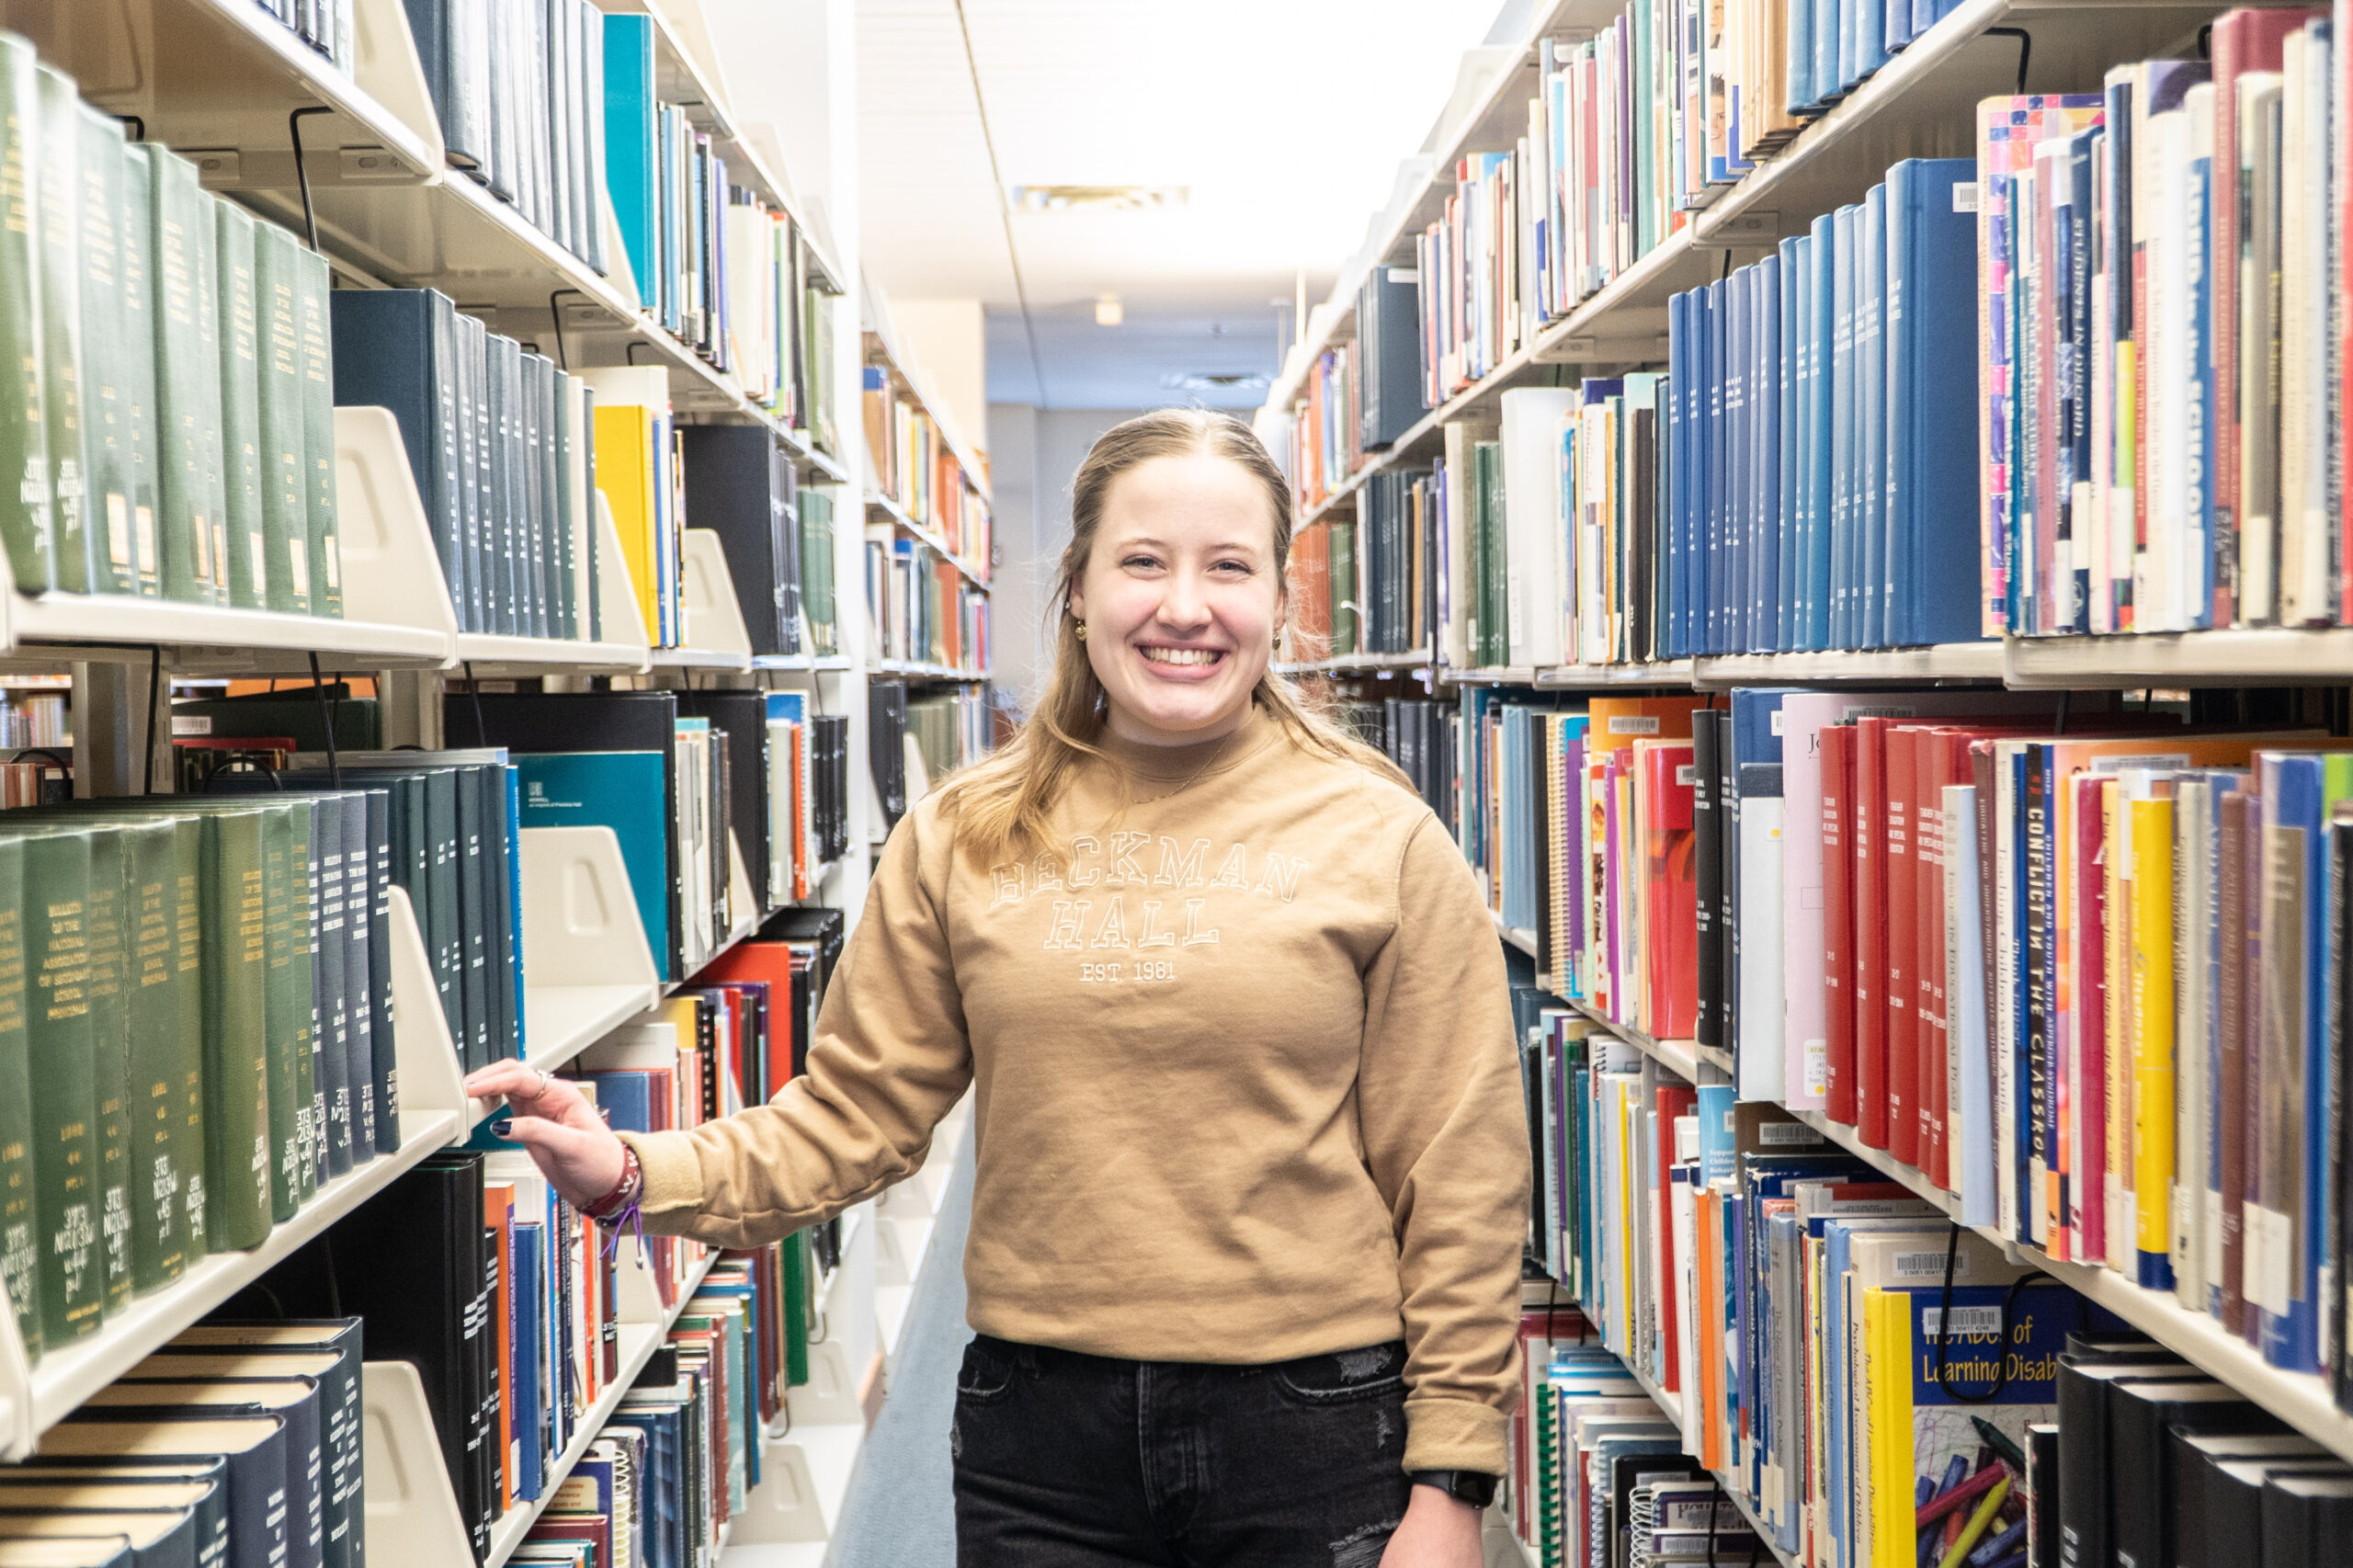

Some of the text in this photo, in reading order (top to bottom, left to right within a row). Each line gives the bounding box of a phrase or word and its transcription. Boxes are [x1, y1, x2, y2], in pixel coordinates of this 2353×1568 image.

[2188, 175, 2204, 283] ADHD
[2074, 218, 2085, 437] STUDENTS IN DISCORD
[989, 832, 1309, 903] BECKMAN
[2027, 808, 2044, 915] CONFLICT
[1042, 896, 1219, 949] HALL
[2029, 926, 2044, 951] IN
[1996, 844, 2010, 1114] Teaching Children with Autis
[2029, 968, 2045, 1017] THE
[2044, 835, 2056, 1130] CHILDREN AND YOUTH WITH ASPERGER SYNDROME
[297, 1108, 311, 1127] 373
[64, 1204, 89, 1230] 373
[1851, 1322, 1860, 1400] Psychological
[2013, 1315, 2033, 1345] of
[1853, 1404, 1861, 1473] Assessment
[1864, 1352, 1876, 1555] The ABCs of Learning Disabilities
[1855, 1477, 1861, 1490] of
